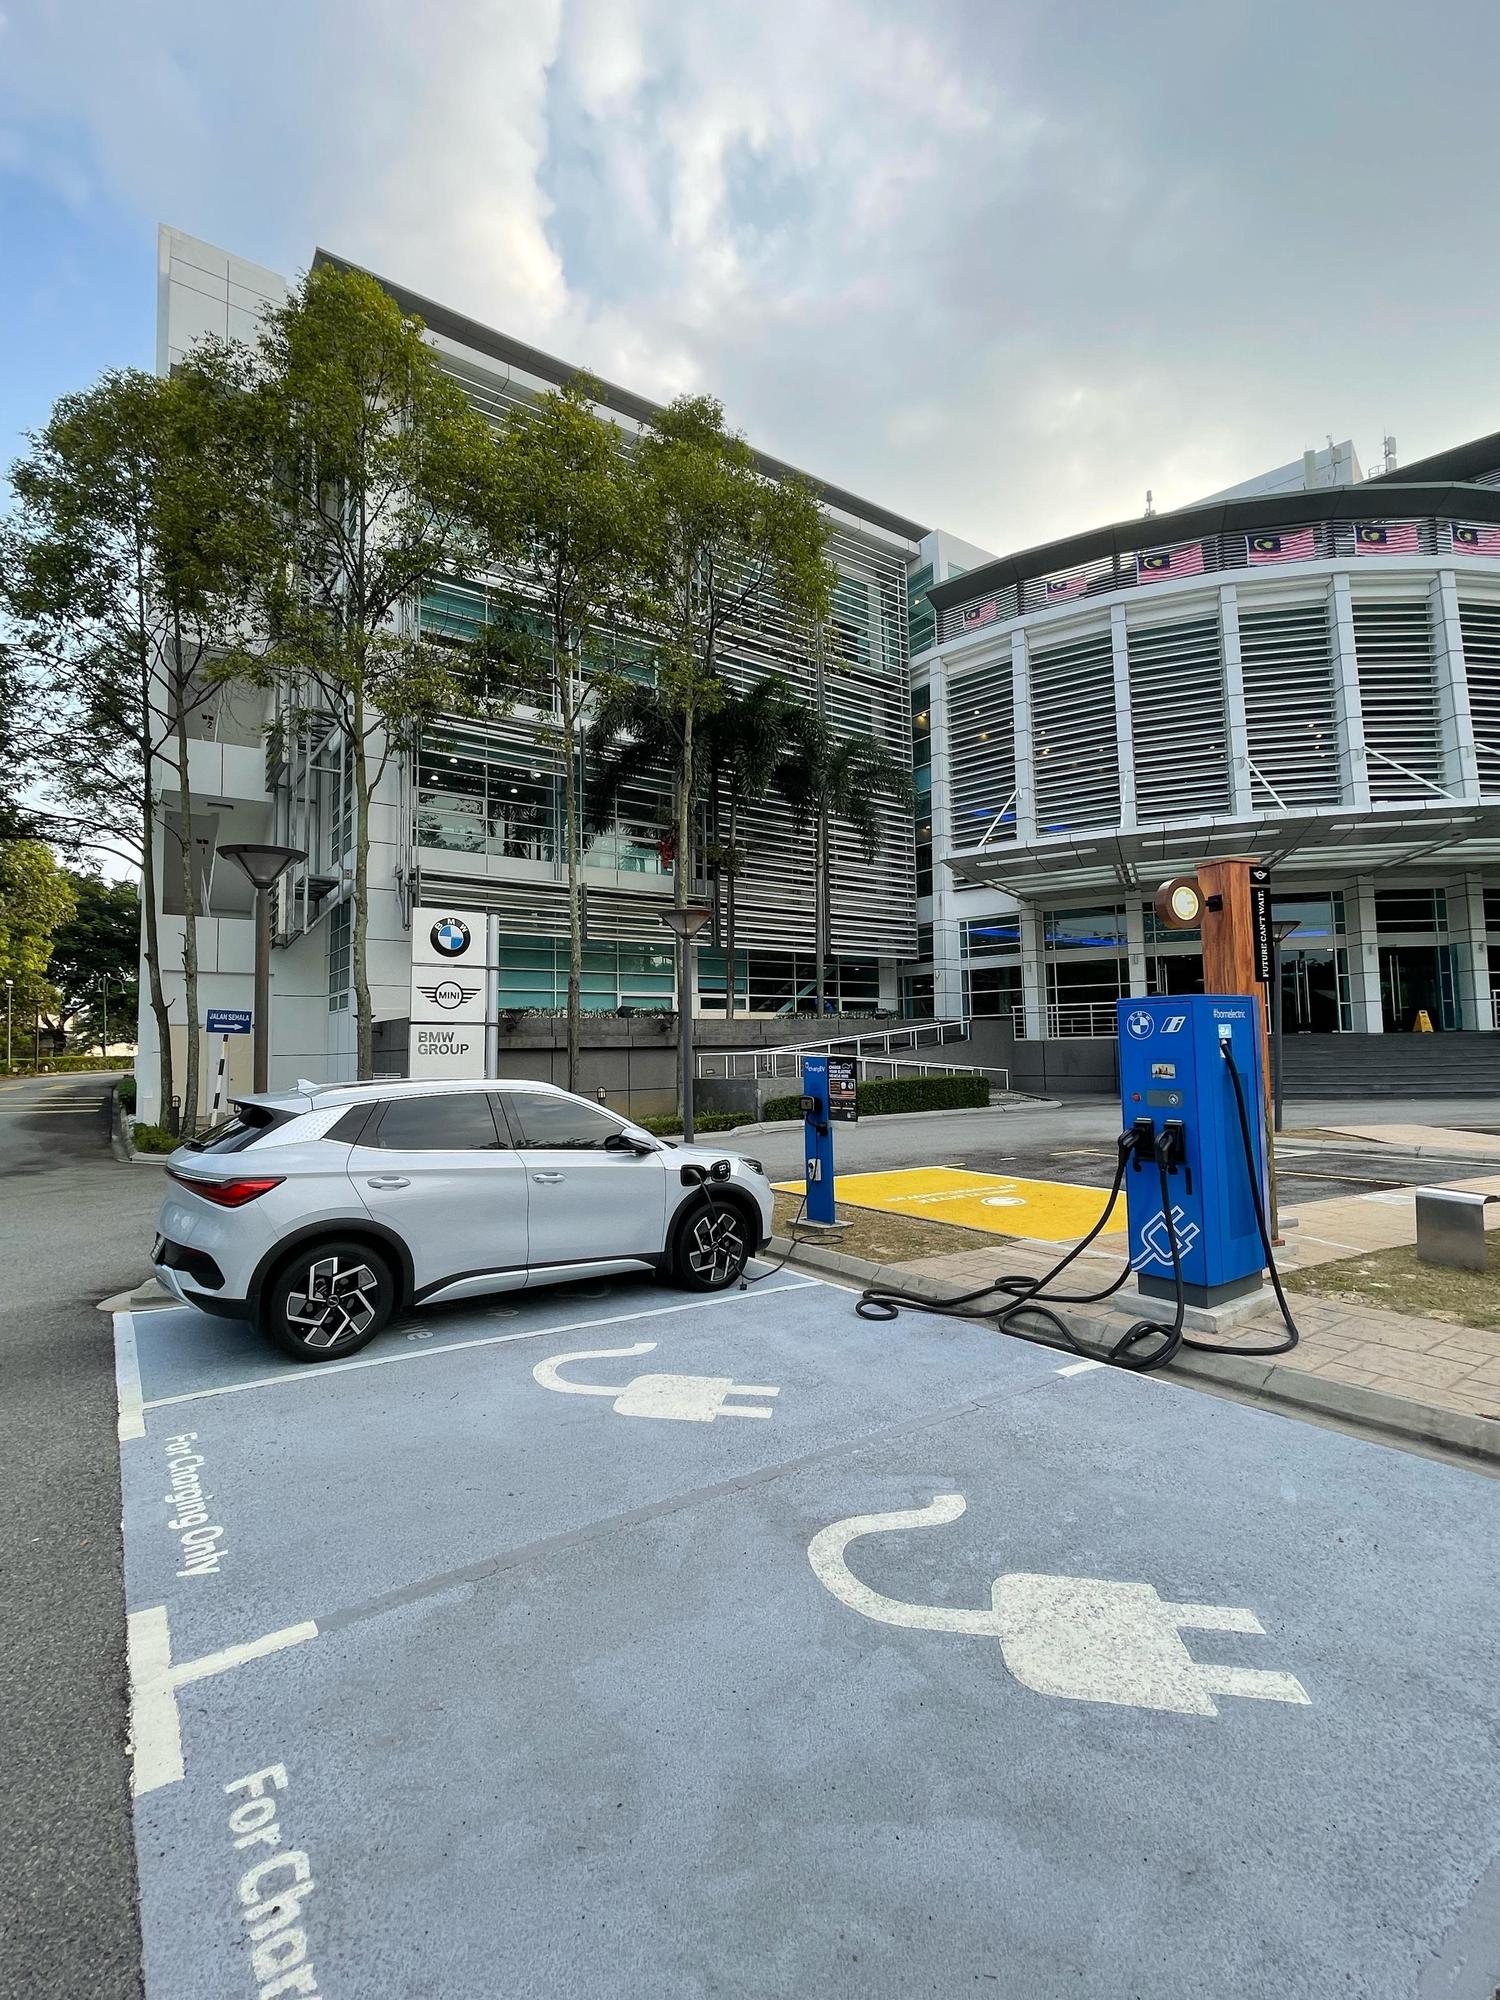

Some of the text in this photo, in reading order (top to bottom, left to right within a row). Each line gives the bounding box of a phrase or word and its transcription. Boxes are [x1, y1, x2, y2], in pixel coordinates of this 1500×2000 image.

[207, 721, 213, 729] 2
[434, 918, 468, 933] BMW
[1257, 890, 1269, 978] FUTURE CAN'T WAIT.
[438, 991, 460, 1000] MINI
[228, 1013, 250, 1021] SEHALA
[418, 1031, 455, 1043] BMW
[417, 1043, 470, 1055] GROUP
[165, 1432, 229, 1578] For Charging Only
[224, 1762, 323, 2000] For Char
